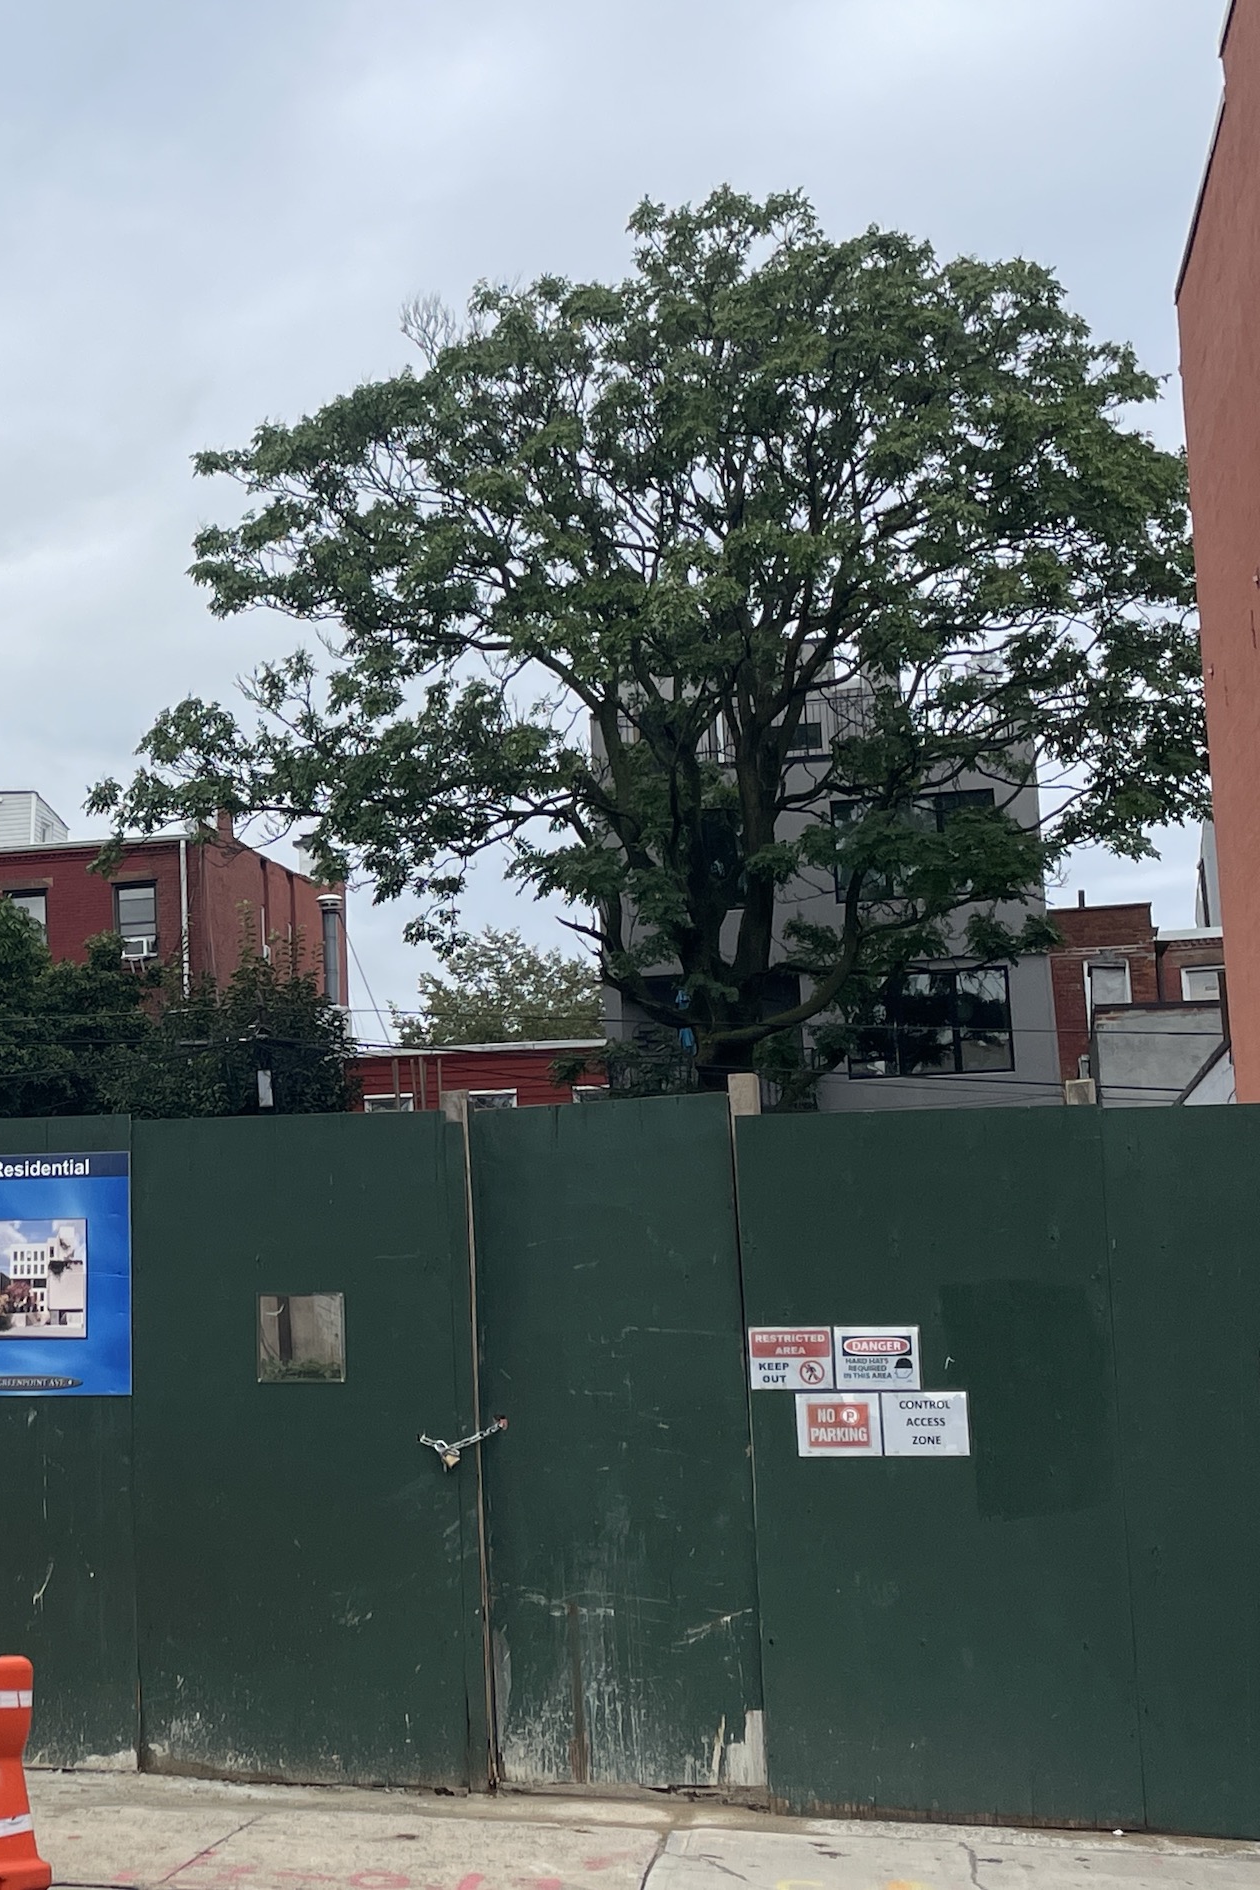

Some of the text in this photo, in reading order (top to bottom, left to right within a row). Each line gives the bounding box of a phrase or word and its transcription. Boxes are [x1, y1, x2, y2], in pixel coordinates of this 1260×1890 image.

[755, 1334, 825, 1343] RESTRICTED
[775, 1346, 806, 1355] AREA
[852, 1341, 901, 1351] DANGER
[869, 1357, 889, 1365] HATS
[758, 1362, 789, 1371] KEEP
[762, 1374, 787, 1383] OUT
[899, 1400, 950, 1410] CONTROL
[817, 1408, 835, 1424] NO
[906, 1417, 946, 1427] ACCESS
[810, 1427, 868, 1442] PARKING
[912, 1436, 941, 1445] ZONE
